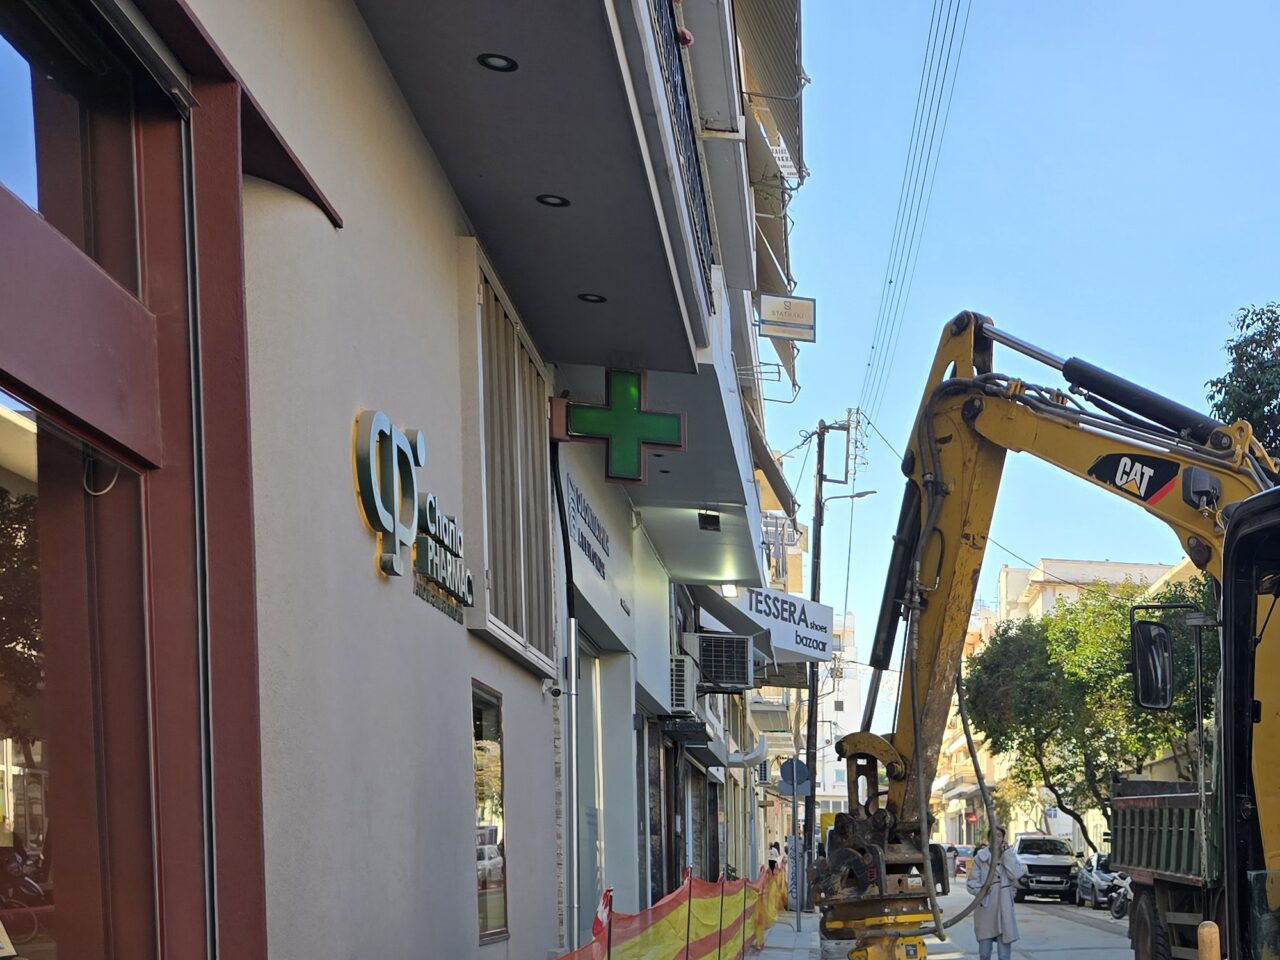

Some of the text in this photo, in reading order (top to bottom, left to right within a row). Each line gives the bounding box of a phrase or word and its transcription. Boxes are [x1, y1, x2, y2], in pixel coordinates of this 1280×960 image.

[1115, 456, 1154, 497] CAT
[426, 492, 464, 559] Chania
[747, 588, 827, 633] TESSERA shoes
[795, 630, 827, 652] bazaar
